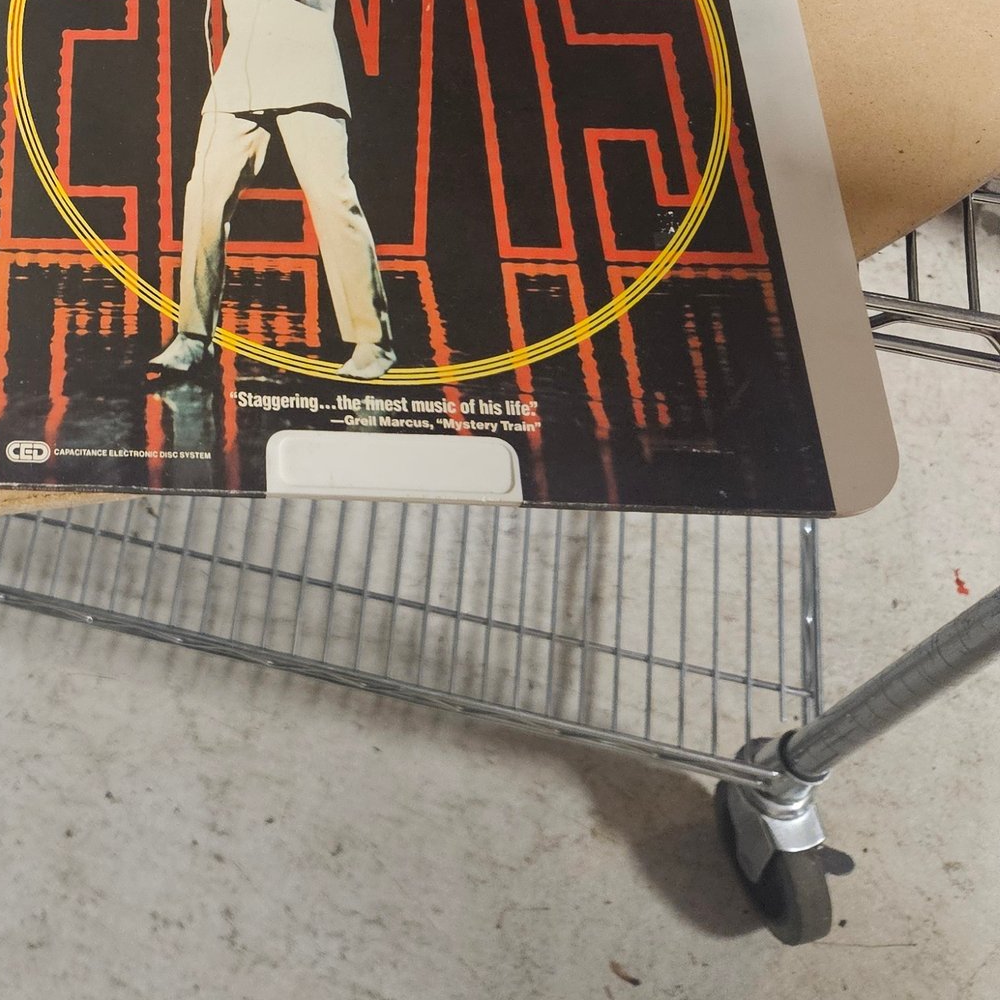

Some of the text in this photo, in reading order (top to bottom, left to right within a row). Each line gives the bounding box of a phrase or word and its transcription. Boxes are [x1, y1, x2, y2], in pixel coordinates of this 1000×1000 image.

[362, 395, 408, 412] finest
[411, 398, 457, 413] music
[459, 399, 477, 414] of
[479, 399, 503, 415] his
[378, 416, 435, 430] Marcus,
[53, 448, 212, 459] CAPACITANCE ELECTRONIC DISC SYSTEM
